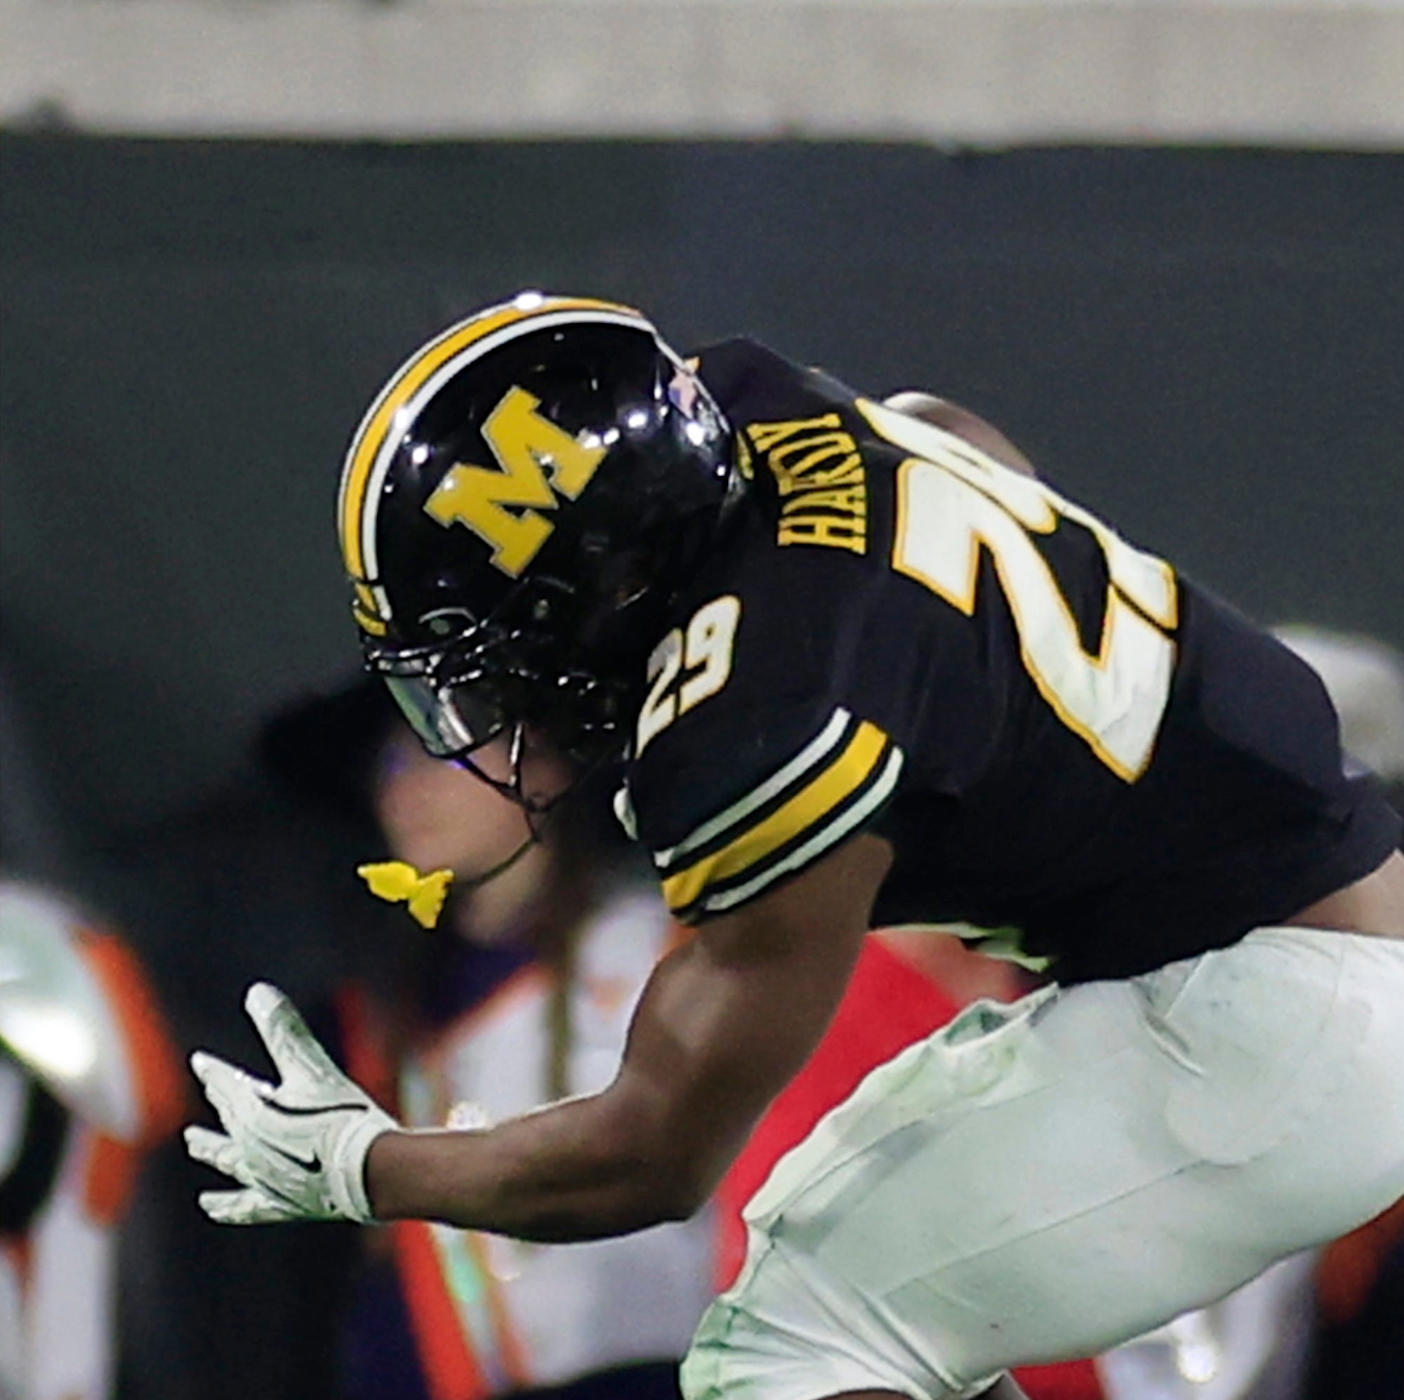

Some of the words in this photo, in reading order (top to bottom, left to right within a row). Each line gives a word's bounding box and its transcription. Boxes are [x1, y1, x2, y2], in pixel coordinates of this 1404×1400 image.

[422, 384, 608, 579] M
[746, 412, 867, 555] HARDY
[634, 594, 743, 760] 29
